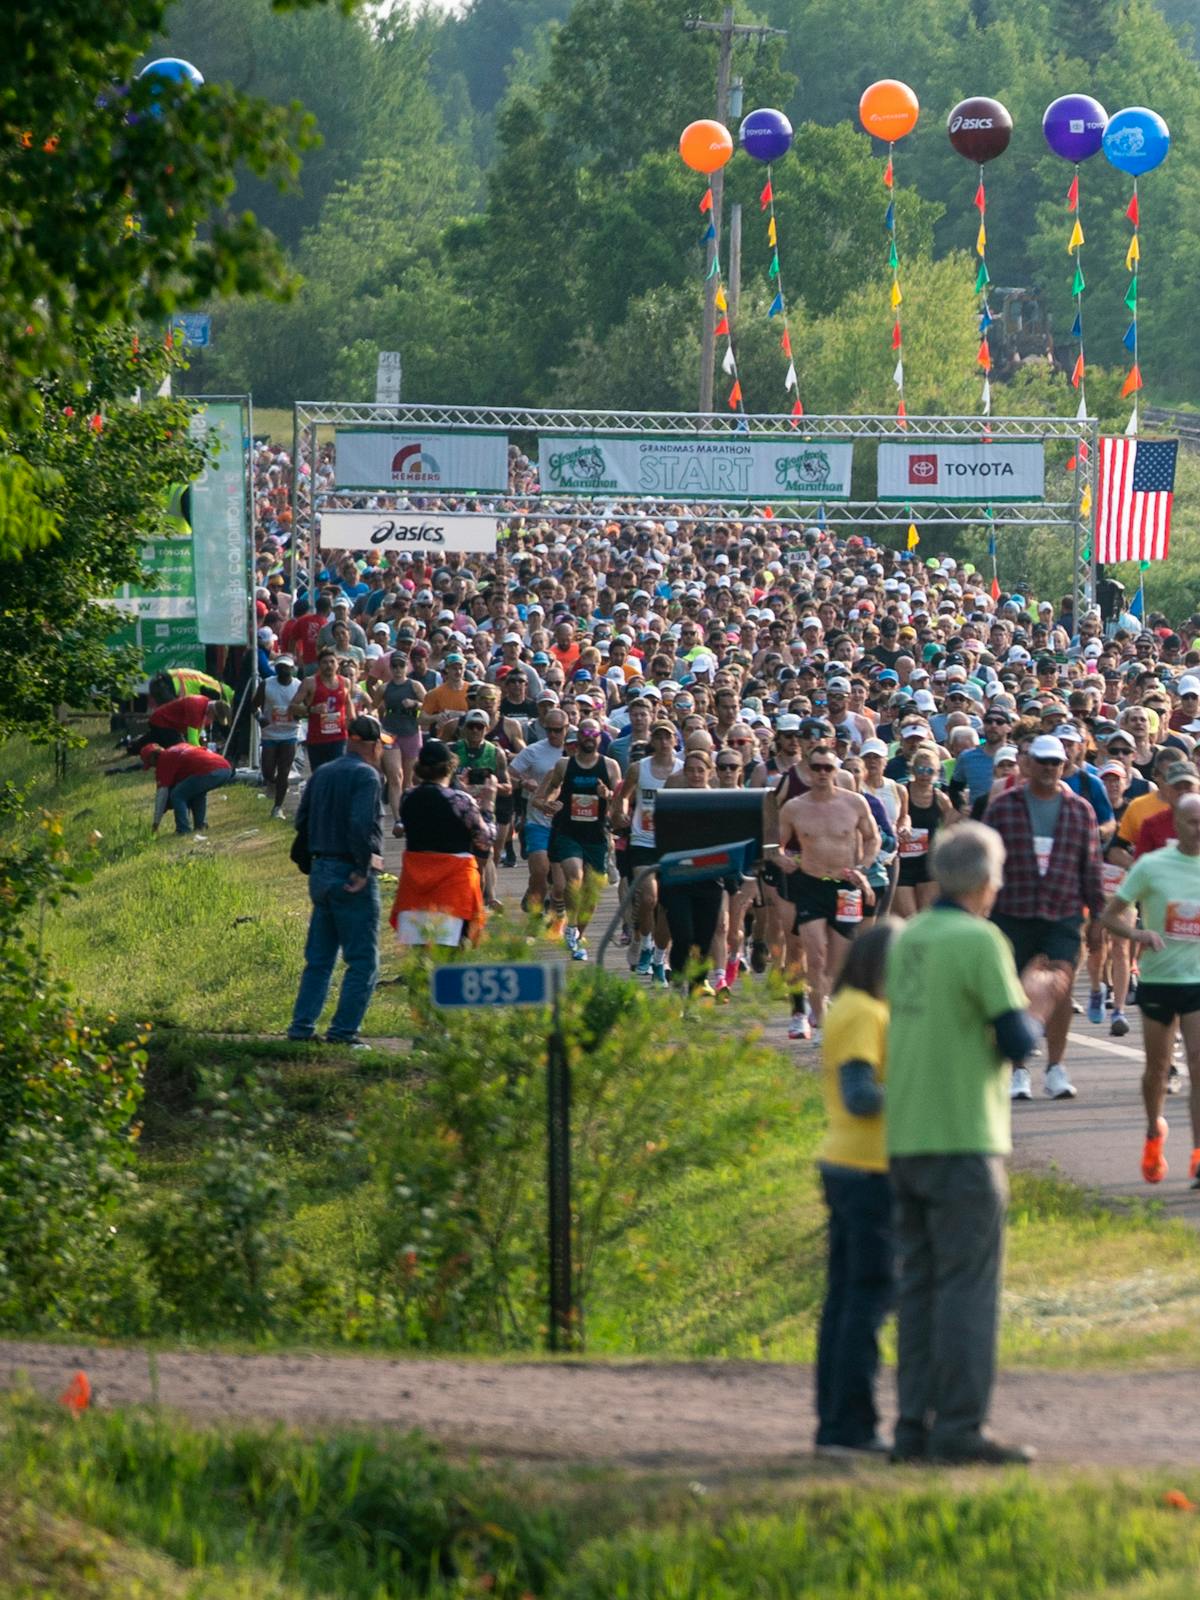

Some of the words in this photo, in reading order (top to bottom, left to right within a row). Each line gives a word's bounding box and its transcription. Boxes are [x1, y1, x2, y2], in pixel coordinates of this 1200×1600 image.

[962, 118, 993, 130] asics
[639, 444, 694, 453] GRANDMAS
[696, 445, 751, 454] MARATHON
[639, 455, 754, 492] START
[944, 463, 1014, 476] TOYOTA
[784, 480, 844, 492] Marathon
[395, 526, 444, 541] asics
[462, 968, 520, 1002] 853
